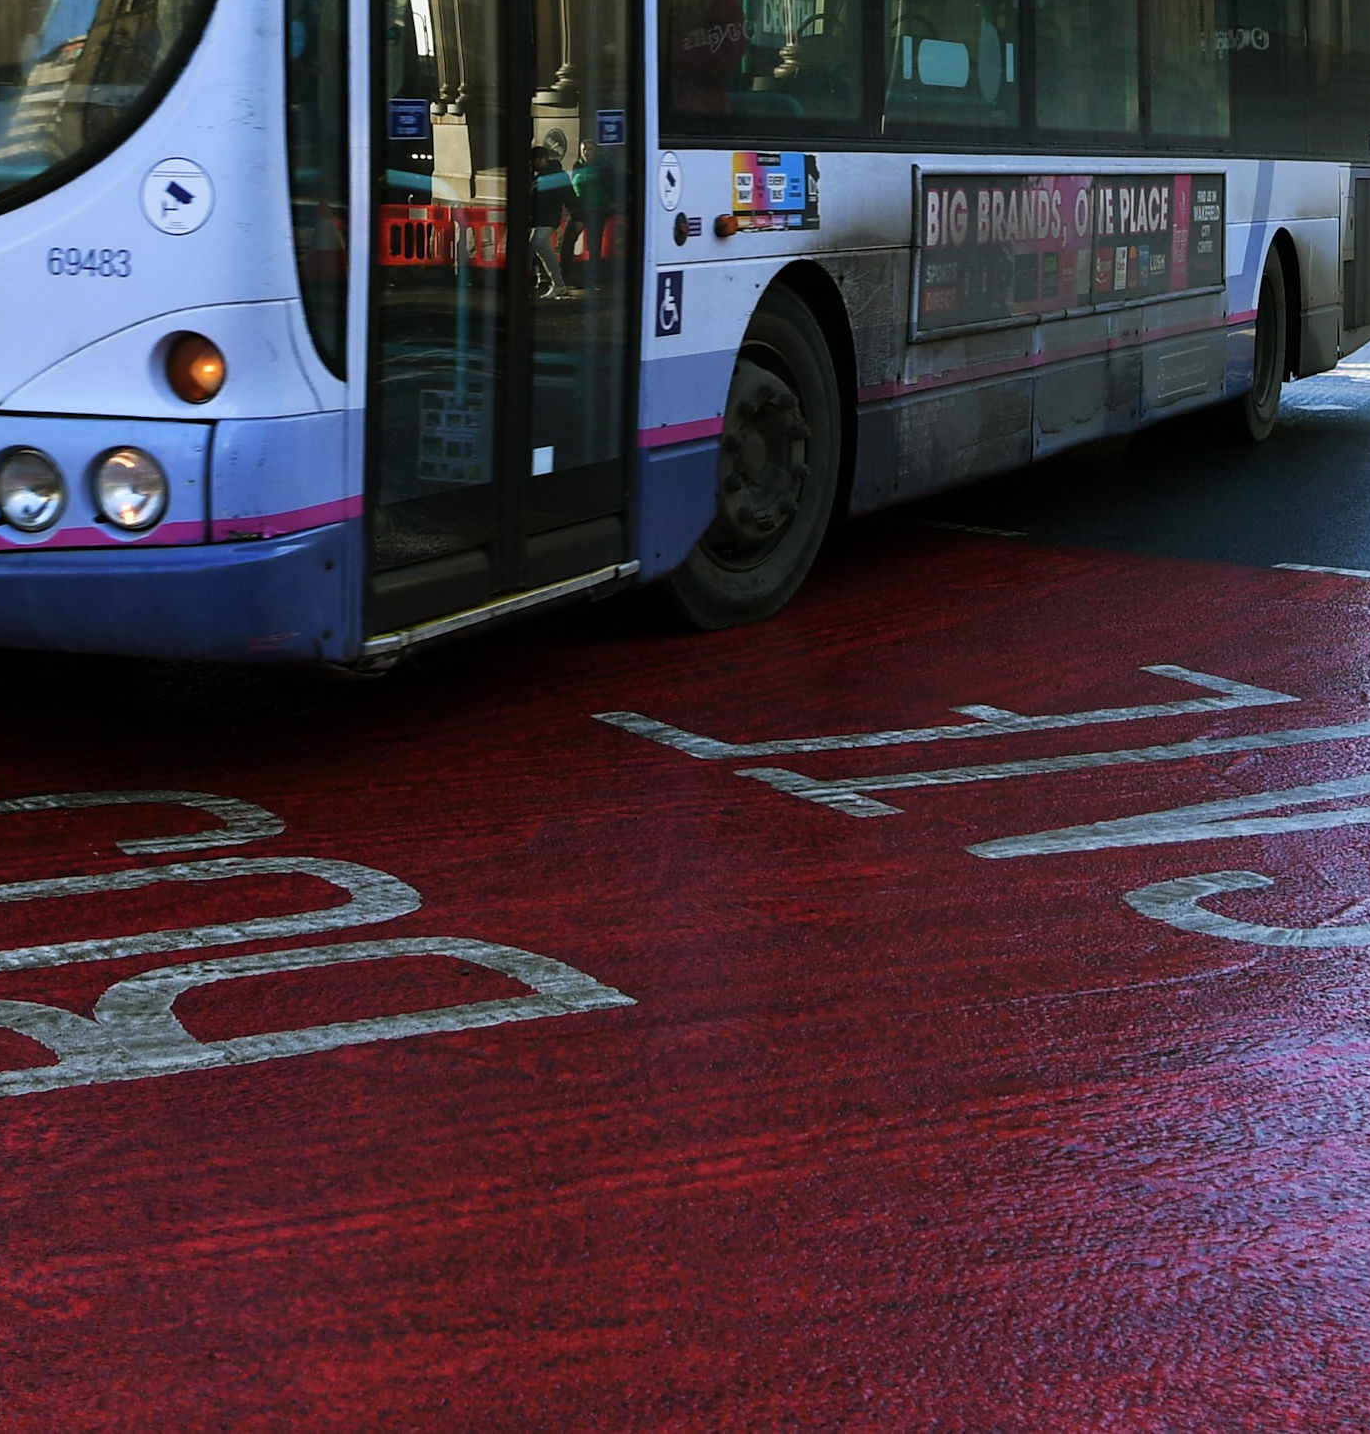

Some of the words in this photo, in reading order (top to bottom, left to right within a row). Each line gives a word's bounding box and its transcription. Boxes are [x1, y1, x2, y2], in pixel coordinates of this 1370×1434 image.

[926, 189, 969, 247] BIG
[977, 188, 1069, 248] BRANDS,
[1119, 186, 1169, 234] PLACE
[46, 246, 133, 278] 69483
